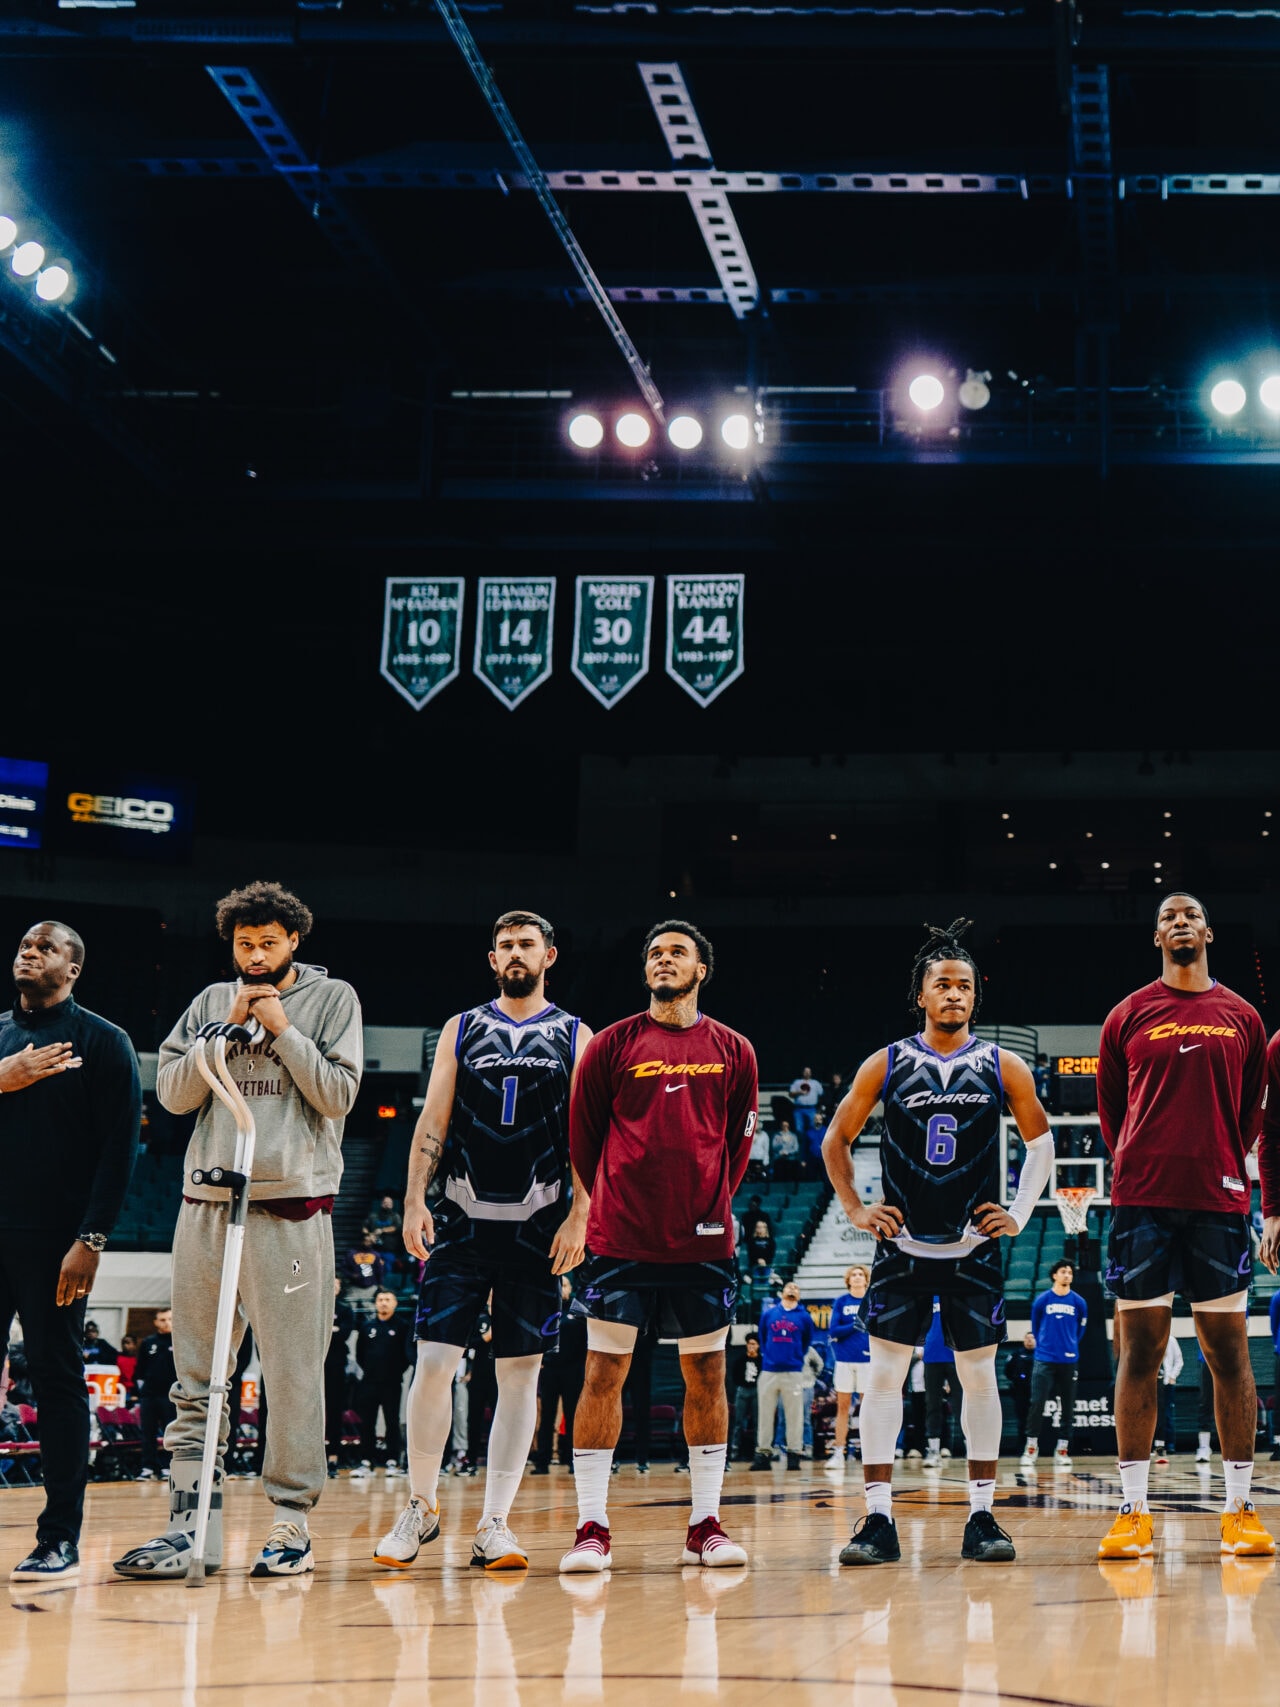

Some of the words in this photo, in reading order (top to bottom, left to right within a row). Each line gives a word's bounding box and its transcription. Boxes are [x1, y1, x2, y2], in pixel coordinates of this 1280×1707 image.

[588, 584, 641, 598] NORRIS
[408, 618, 441, 647] 10
[499, 618, 532, 647] 14
[592, 617, 632, 646] 30
[682, 615, 731, 645] 44
[67, 792, 174, 823] GEICO
[1144, 1023, 1237, 1041] CHARGE
[470, 1053, 560, 1069] CHARGE
[628, 1060, 725, 1078] CHARGE
[501, 1075, 519, 1125] 1
[902, 1090, 991, 1109] CHARGE
[925, 1113, 958, 1165] 6
[1042, 1395, 1109, 1417] plnet
[1051, 1411, 1117, 1428] fness
